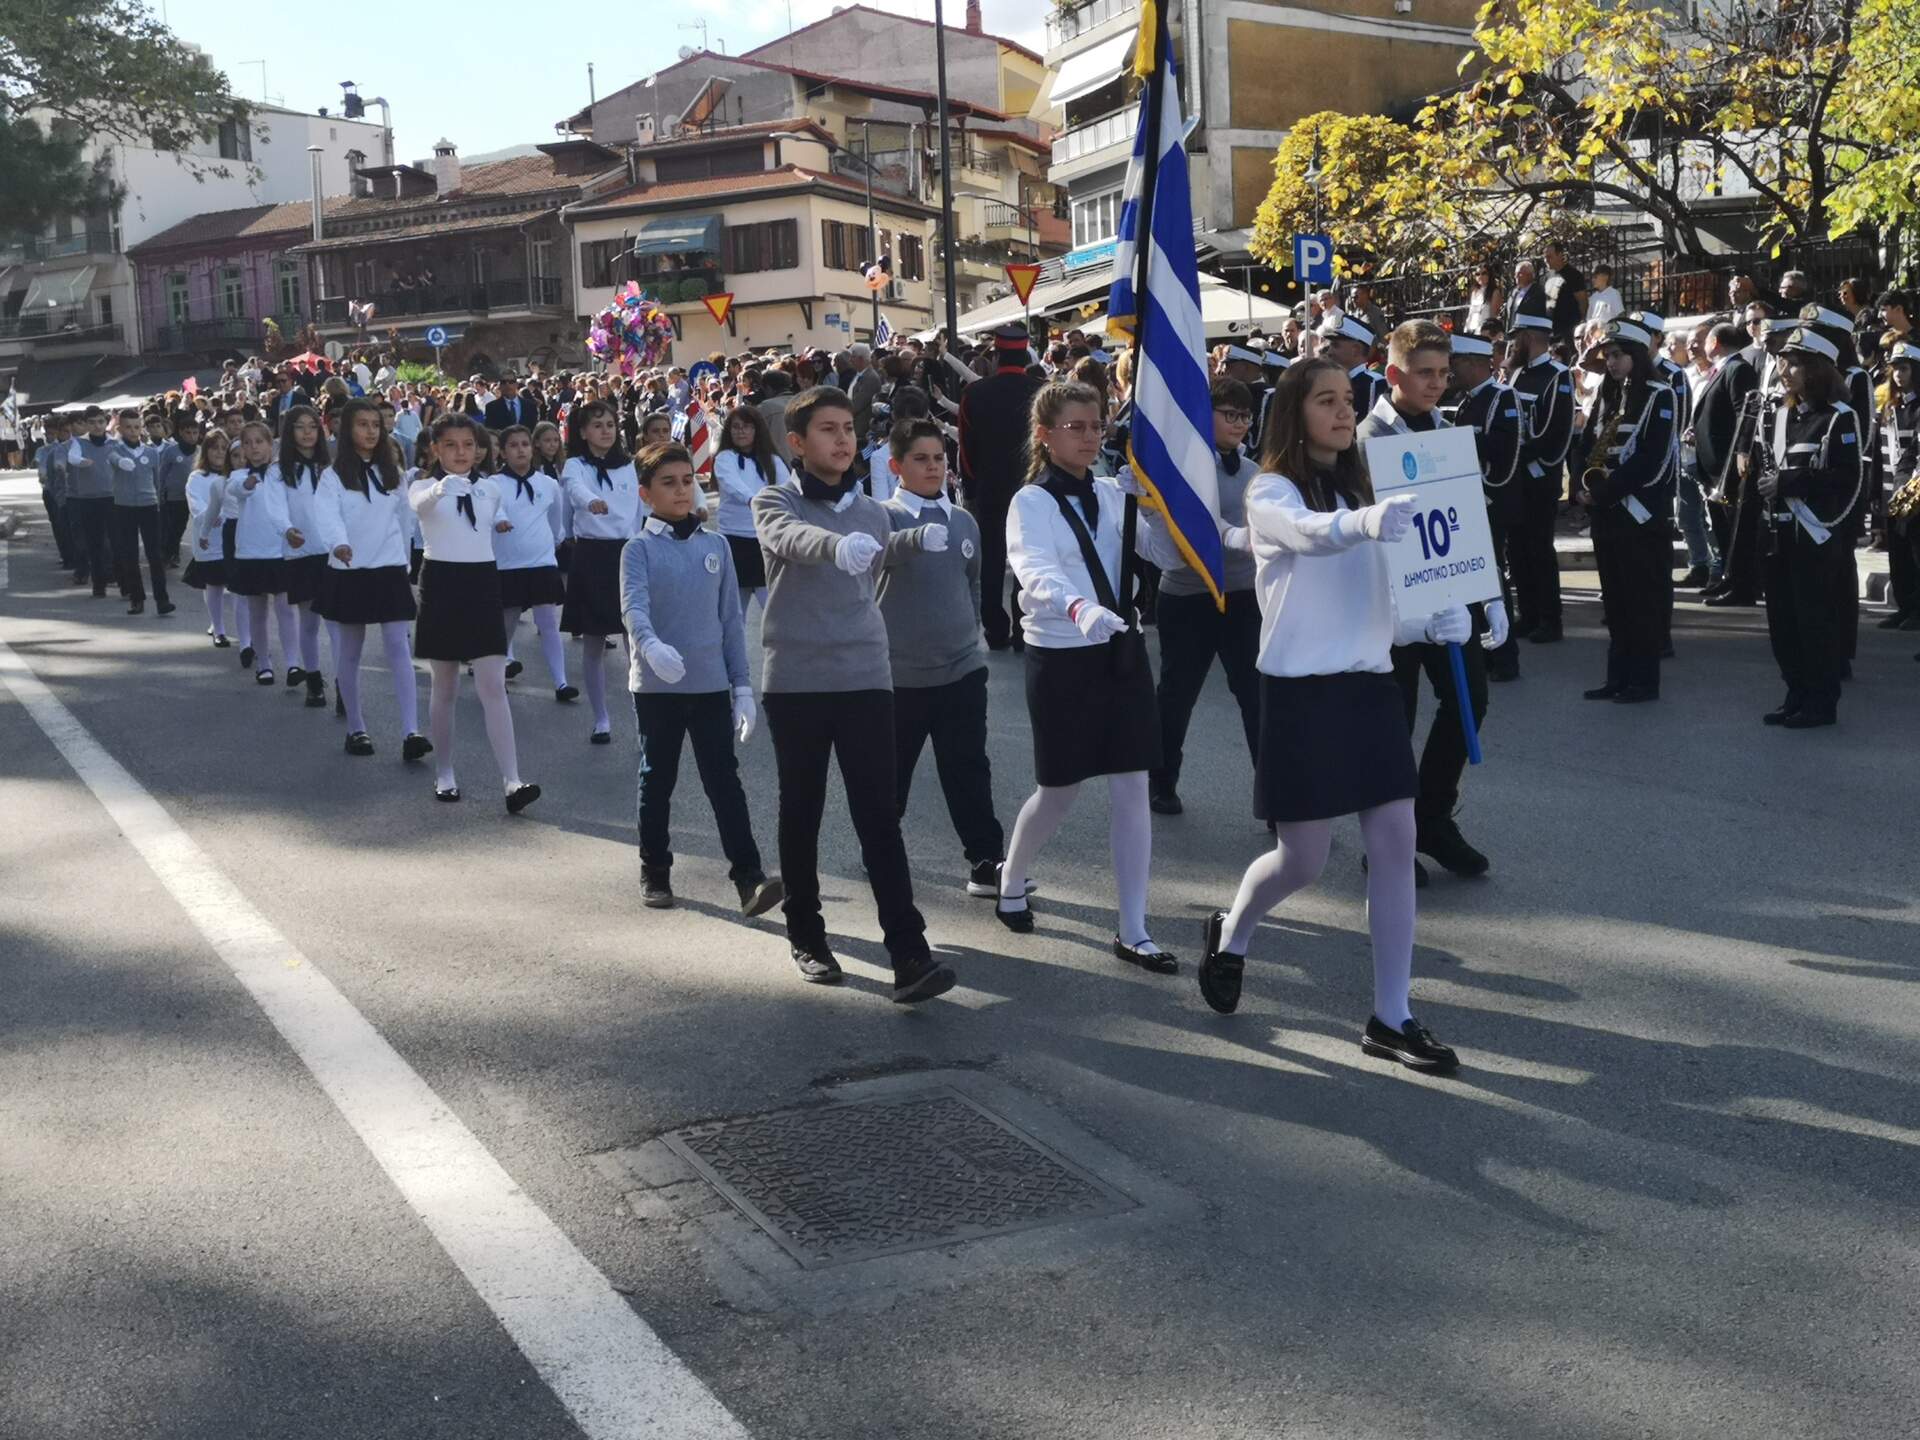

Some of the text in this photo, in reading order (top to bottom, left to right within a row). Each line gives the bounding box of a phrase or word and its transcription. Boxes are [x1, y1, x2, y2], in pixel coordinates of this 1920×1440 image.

[1301, 239, 1325, 278] P
[1404, 556, 1486, 588] ΔΗΜΟΤΙΚΟ ΣΧΟΛΕΙΟ
